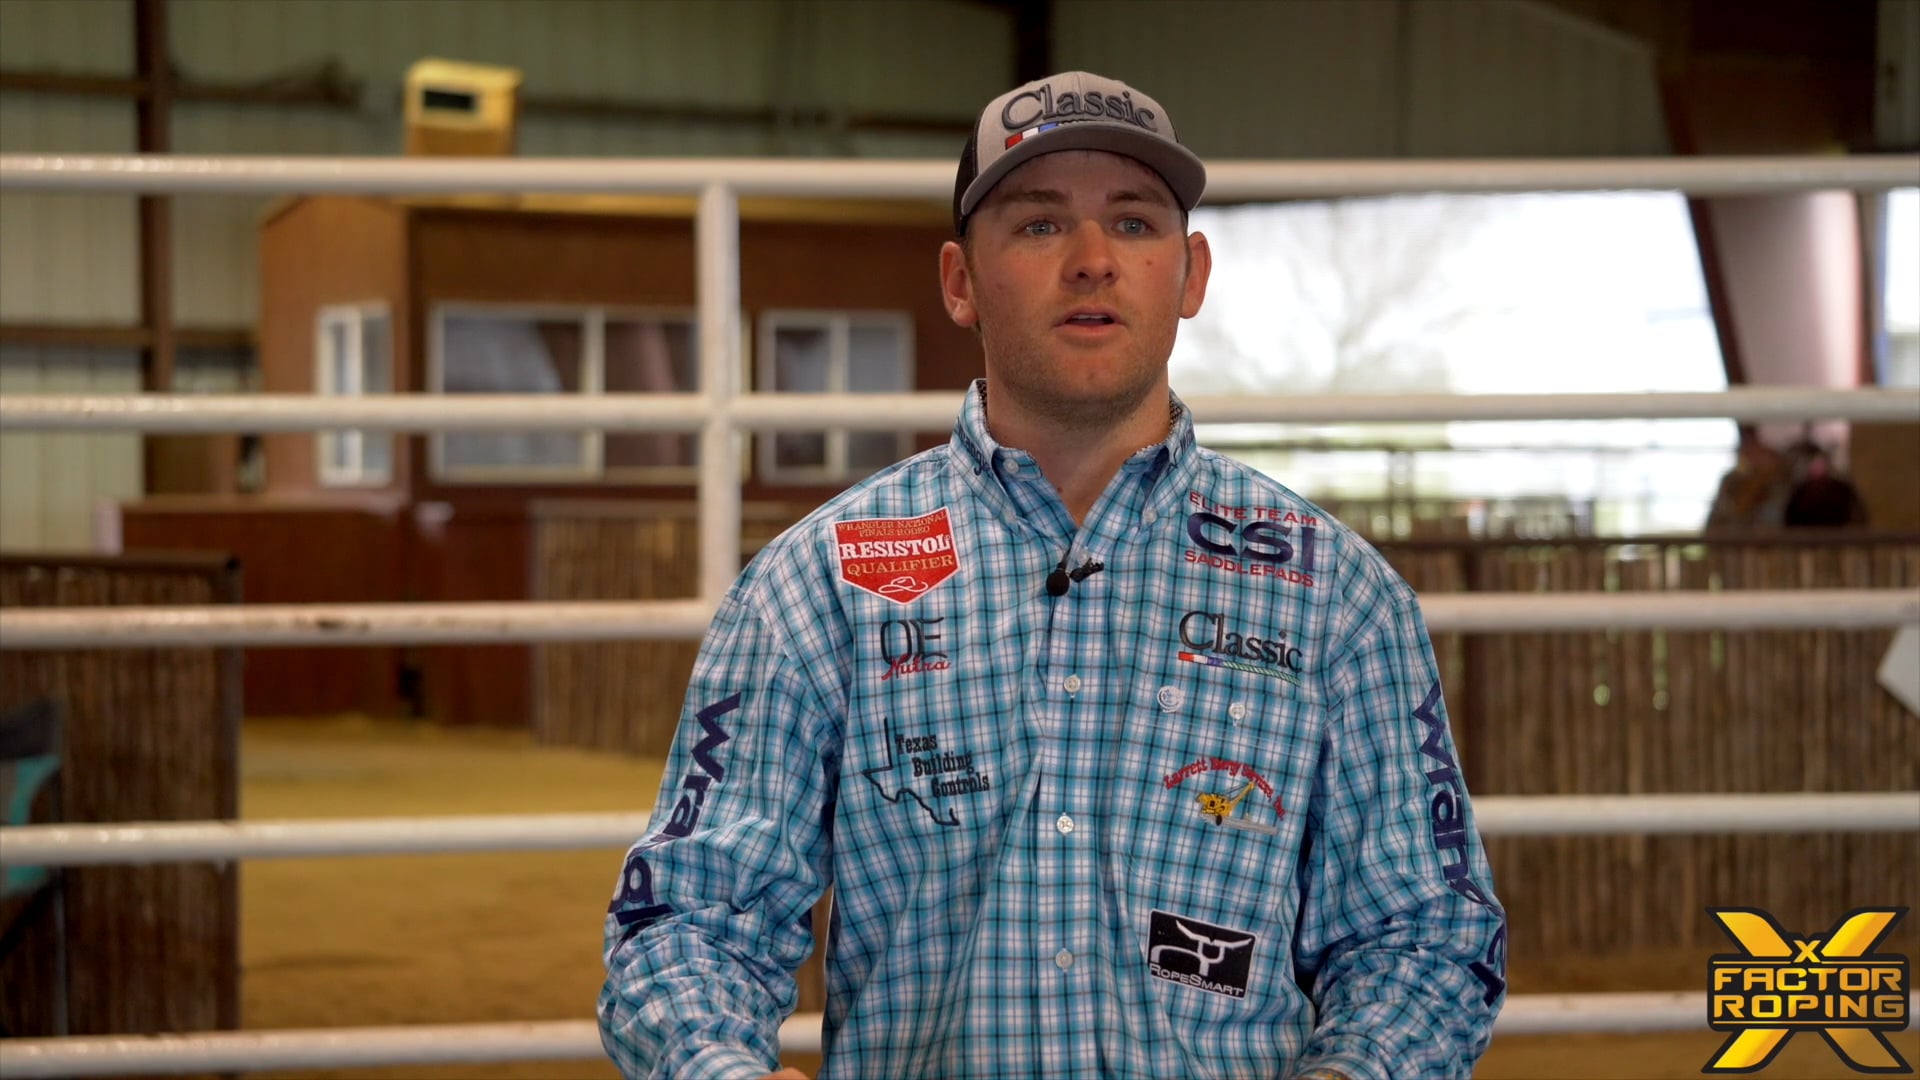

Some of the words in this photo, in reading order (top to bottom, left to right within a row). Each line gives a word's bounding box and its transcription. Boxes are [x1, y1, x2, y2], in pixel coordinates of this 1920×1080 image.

[1001, 83, 1158, 132] Classic
[837, 520, 894, 531] WRANGLER
[897, 511, 948, 528] NATIONAL
[1189, 492, 1247, 520] ELITE
[1254, 507, 1317, 526] TEAM
[859, 528, 894, 538] FINALS
[896, 525, 930, 536] RODEO
[1187, 512, 1316, 572] CSI
[839, 533, 951, 560] RESISTOL
[847, 554, 955, 576] QUALIFIER
[1184, 550, 1314, 587] SADDLEPADS
[1178, 611, 1303, 673] Classic
[895, 734, 938, 755] Texas
[912, 750, 974, 777] Building
[931, 774, 990, 798] Controls
